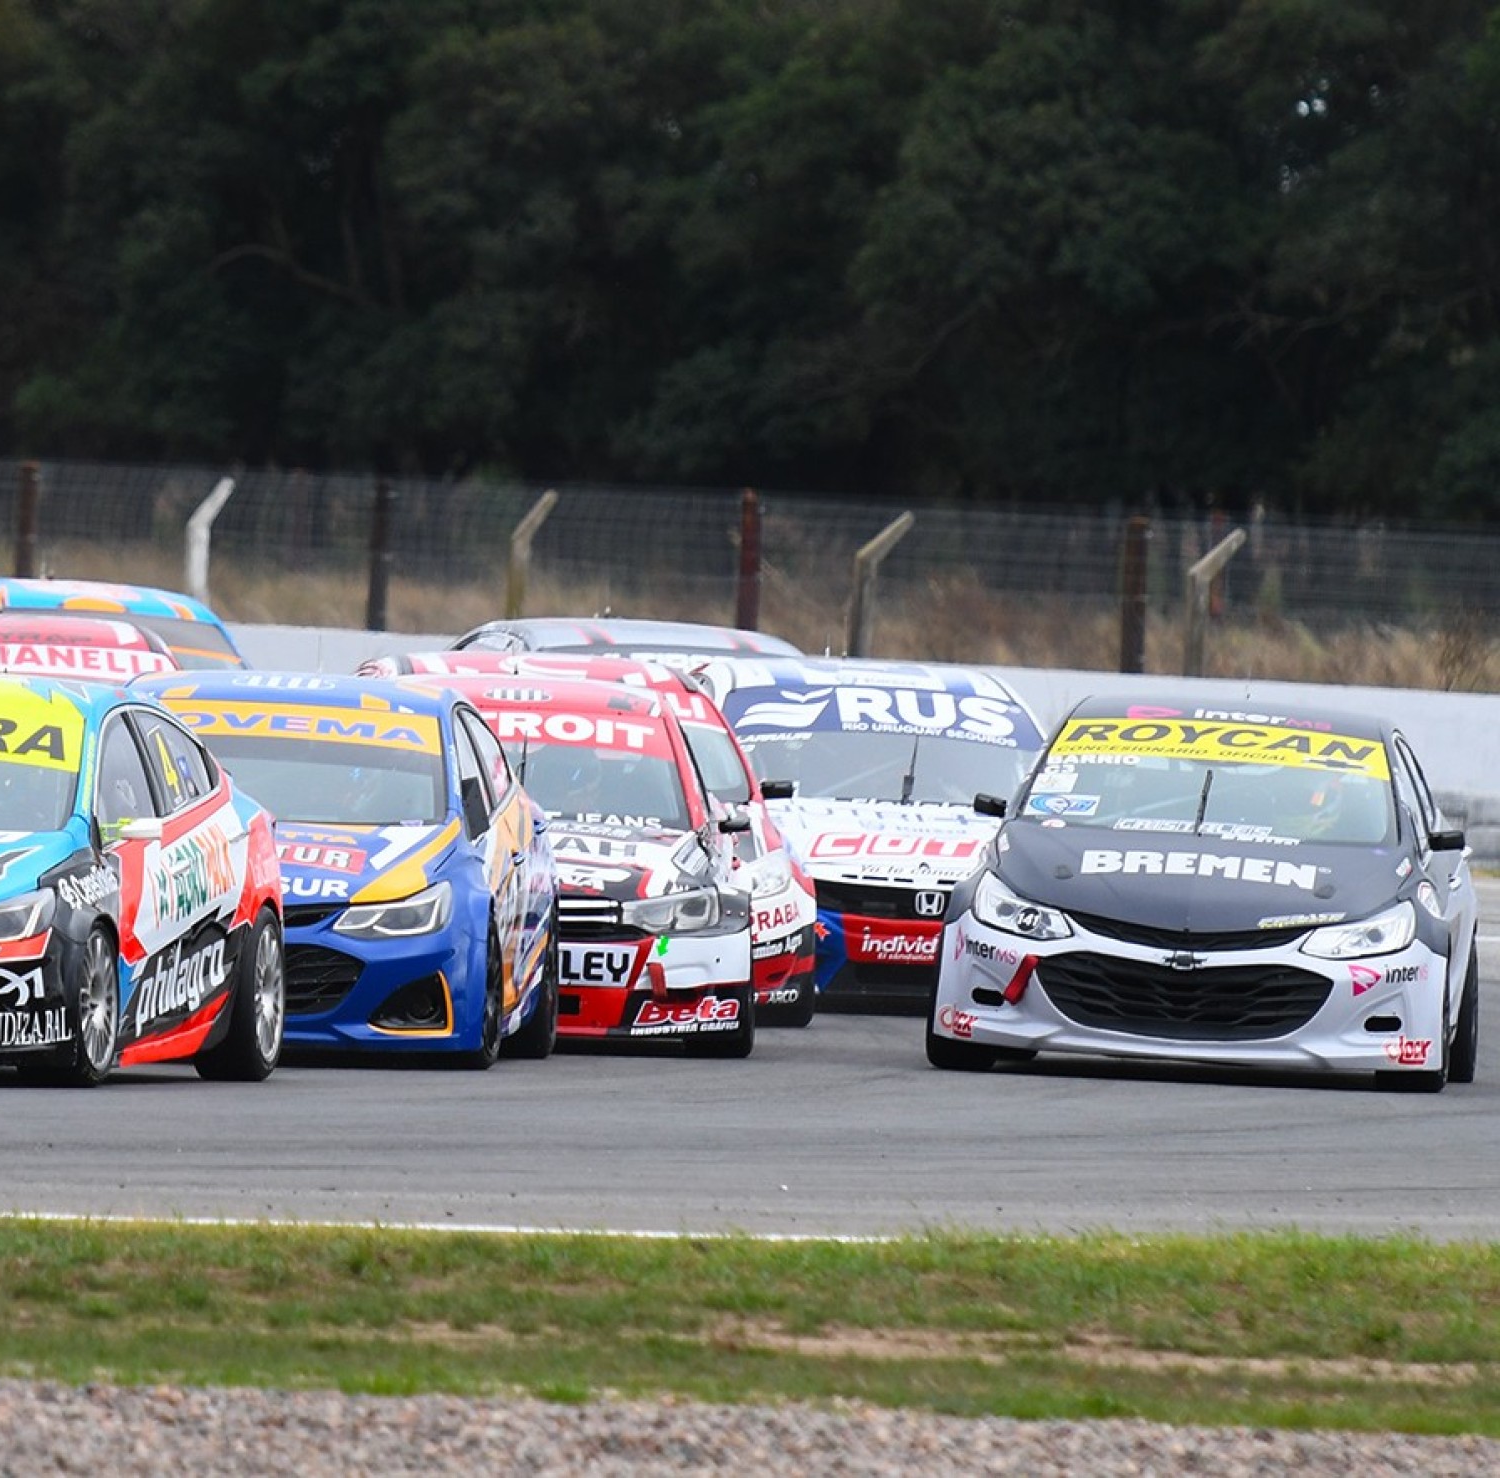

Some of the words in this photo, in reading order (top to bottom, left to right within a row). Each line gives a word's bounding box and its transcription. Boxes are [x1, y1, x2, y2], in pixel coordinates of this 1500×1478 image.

[835, 687, 1015, 738] RUS
[1065, 723, 1377, 761] ROYCAN
[1081, 849, 1317, 890] BREMEN
[560, 950, 630, 983] LEY
[135, 938, 225, 1039] philagro
[632, 996, 741, 1027] beta
